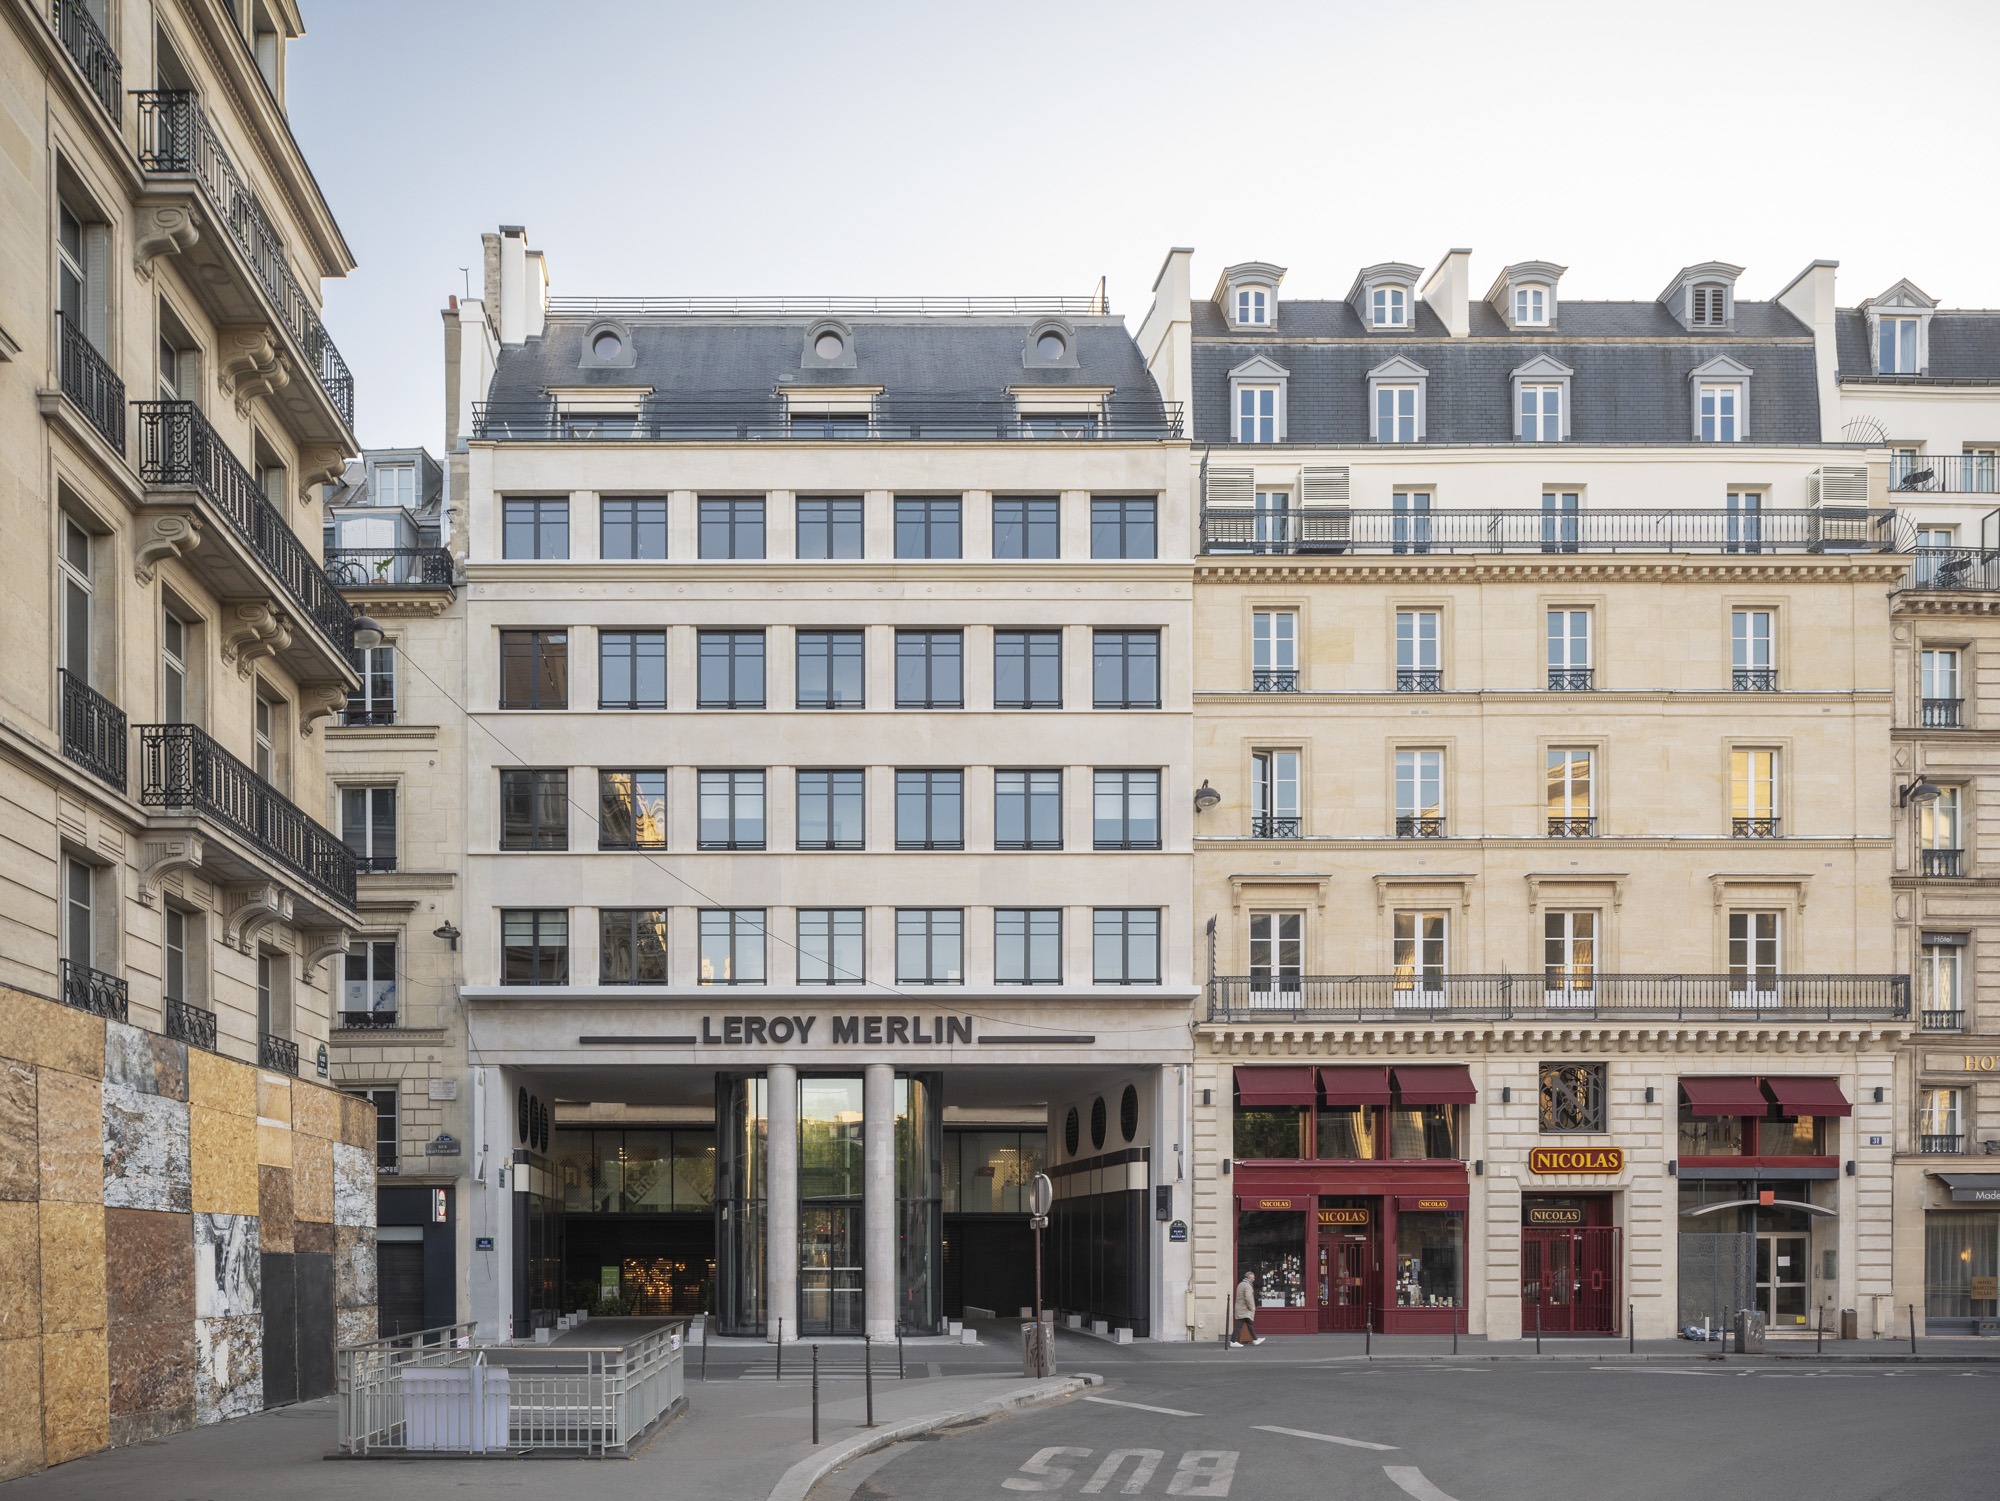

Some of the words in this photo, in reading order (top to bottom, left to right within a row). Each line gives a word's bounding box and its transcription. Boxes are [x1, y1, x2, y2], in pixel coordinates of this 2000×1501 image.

[1933, 935, 1953, 943] Hôtel
[702, 1016, 817, 1044] LEROY
[832, 1016, 972, 1044] MERLIN
[1536, 1152, 1619, 1168] NICOLAS
[1318, 1211, 1366, 1222] NICOLAS
[1533, 1211, 1578, 1220] NICOLAS
[1000, 1446, 1241, 1497] BUS
